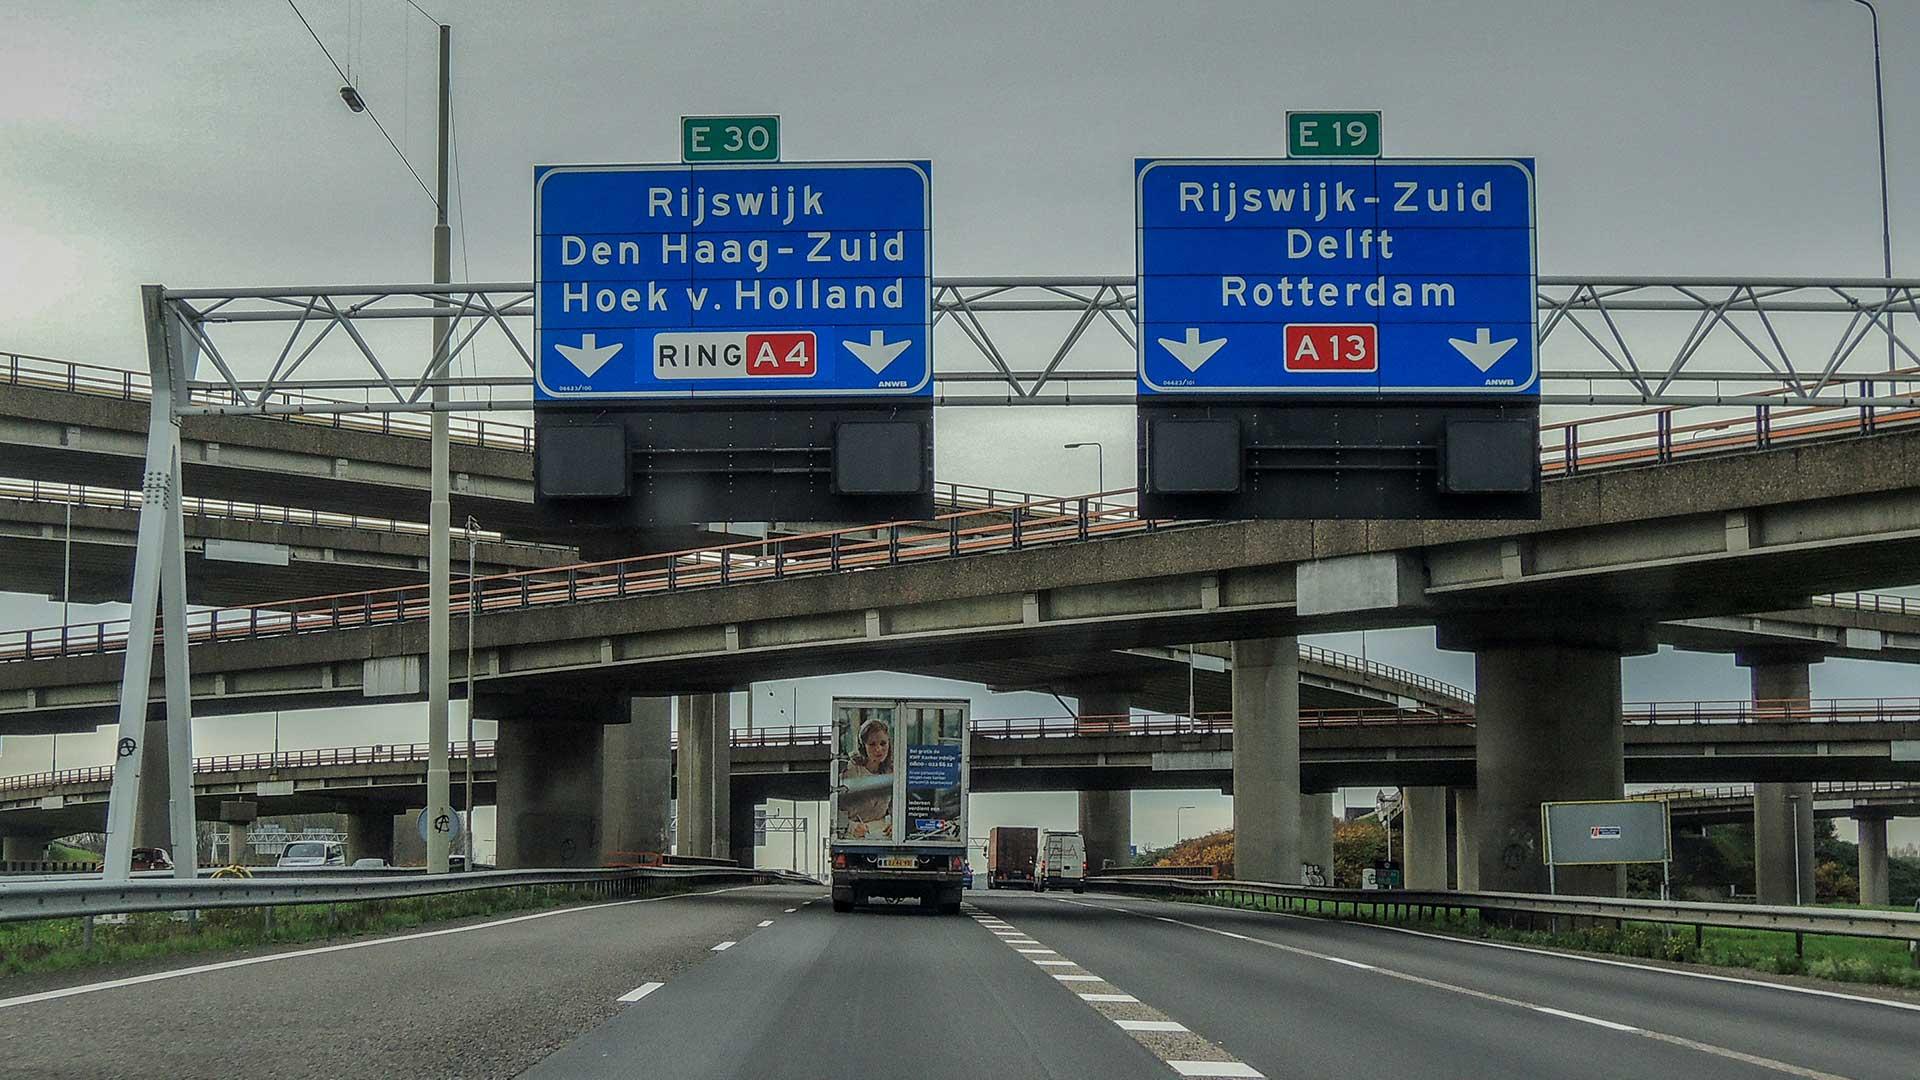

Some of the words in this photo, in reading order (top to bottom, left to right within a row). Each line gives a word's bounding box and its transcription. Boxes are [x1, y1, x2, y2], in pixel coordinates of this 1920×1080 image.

[691, 126, 711, 152] E
[723, 125, 770, 152] 30
[1299, 121, 1319, 147] E
[1332, 121, 1368, 147] 19
[648, 184, 824, 226] Rijswijk
[561, 235, 640, 266] Den
[1286, 228, 1393, 259] Delft
[563, 281, 668, 313] Hoek
[686, 286, 721, 311] v.
[735, 278, 904, 310] Holland
[1221, 276, 1455, 307] Rotterdam
[658, 344, 742, 368] RING
[753, 341, 809, 368] A4
[878, 380, 908, 388] ANWB
